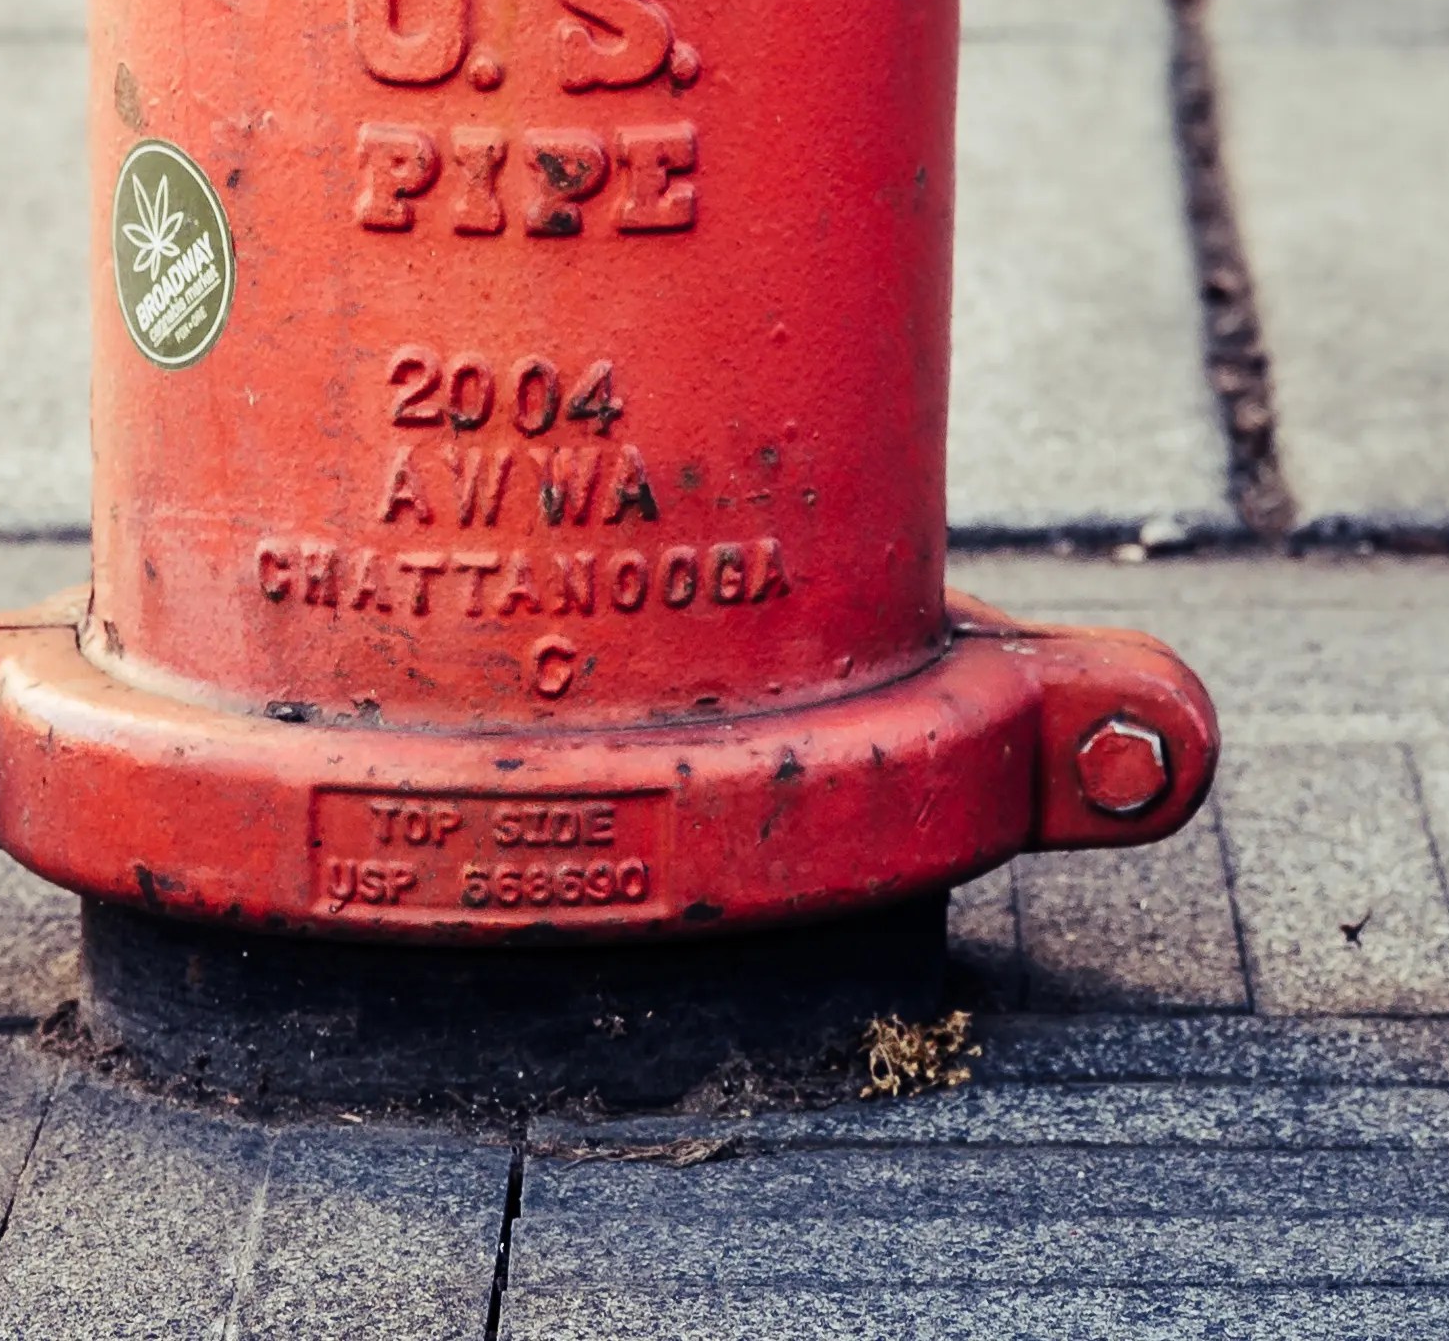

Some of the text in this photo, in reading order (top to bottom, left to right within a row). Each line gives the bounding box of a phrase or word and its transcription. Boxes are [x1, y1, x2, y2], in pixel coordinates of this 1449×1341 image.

[358, 121, 697, 238] PIPE
[135, 231, 215, 333] BROADWAY
[149, 264, 220, 343] cannabis market
[387, 343, 624, 438] 2004
[382, 444, 659, 526] AWWA
[255, 535, 794, 617] CHATTANOOGA
[370, 798, 615, 848] TOP SIDE
[326, 858, 419, 905] USP
